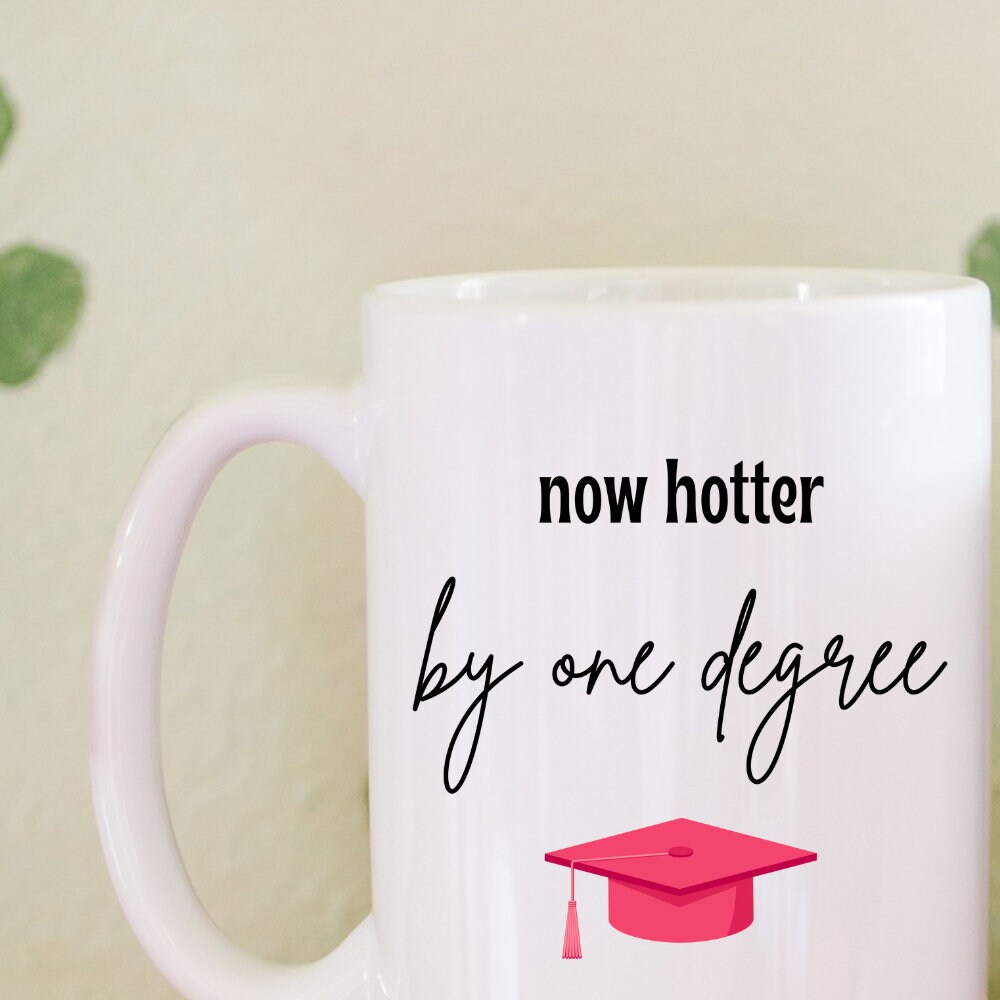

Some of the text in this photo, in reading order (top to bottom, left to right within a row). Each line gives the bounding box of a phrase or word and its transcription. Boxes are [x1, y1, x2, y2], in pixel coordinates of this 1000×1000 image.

[539, 458, 825, 525] now hotter
[412, 576, 948, 795] by one degree
